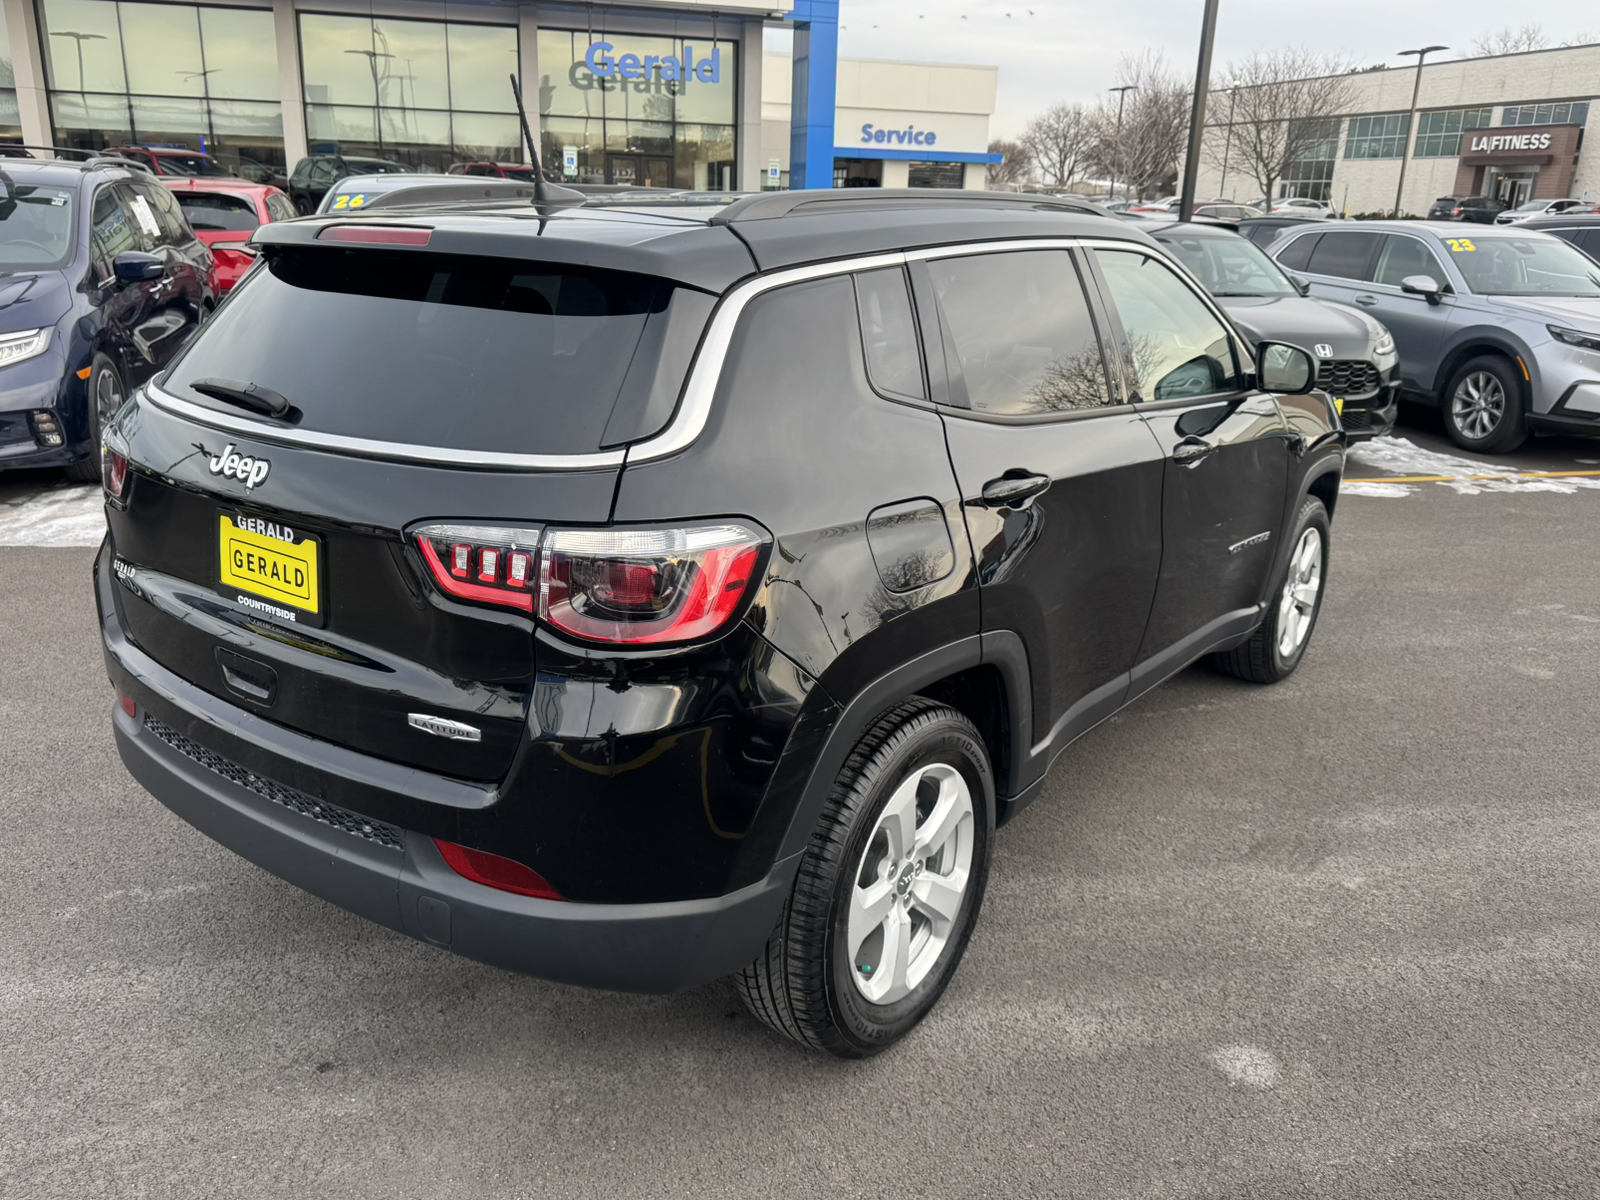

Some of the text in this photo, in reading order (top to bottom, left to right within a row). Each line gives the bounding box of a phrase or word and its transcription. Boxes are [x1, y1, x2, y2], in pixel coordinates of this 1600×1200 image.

[586, 41, 720, 84] Gerald
[861, 123, 937, 146] Service
[333, 194, 365, 209] 26
[1446, 238, 1476, 252] 23
[209, 443, 270, 489] Jeep
[237, 515, 295, 543] GERALD
[233, 549, 305, 588] GERALD
[238, 595, 296, 622] COUNTRYSIDE
[414, 719, 472, 738] LATITUDE
